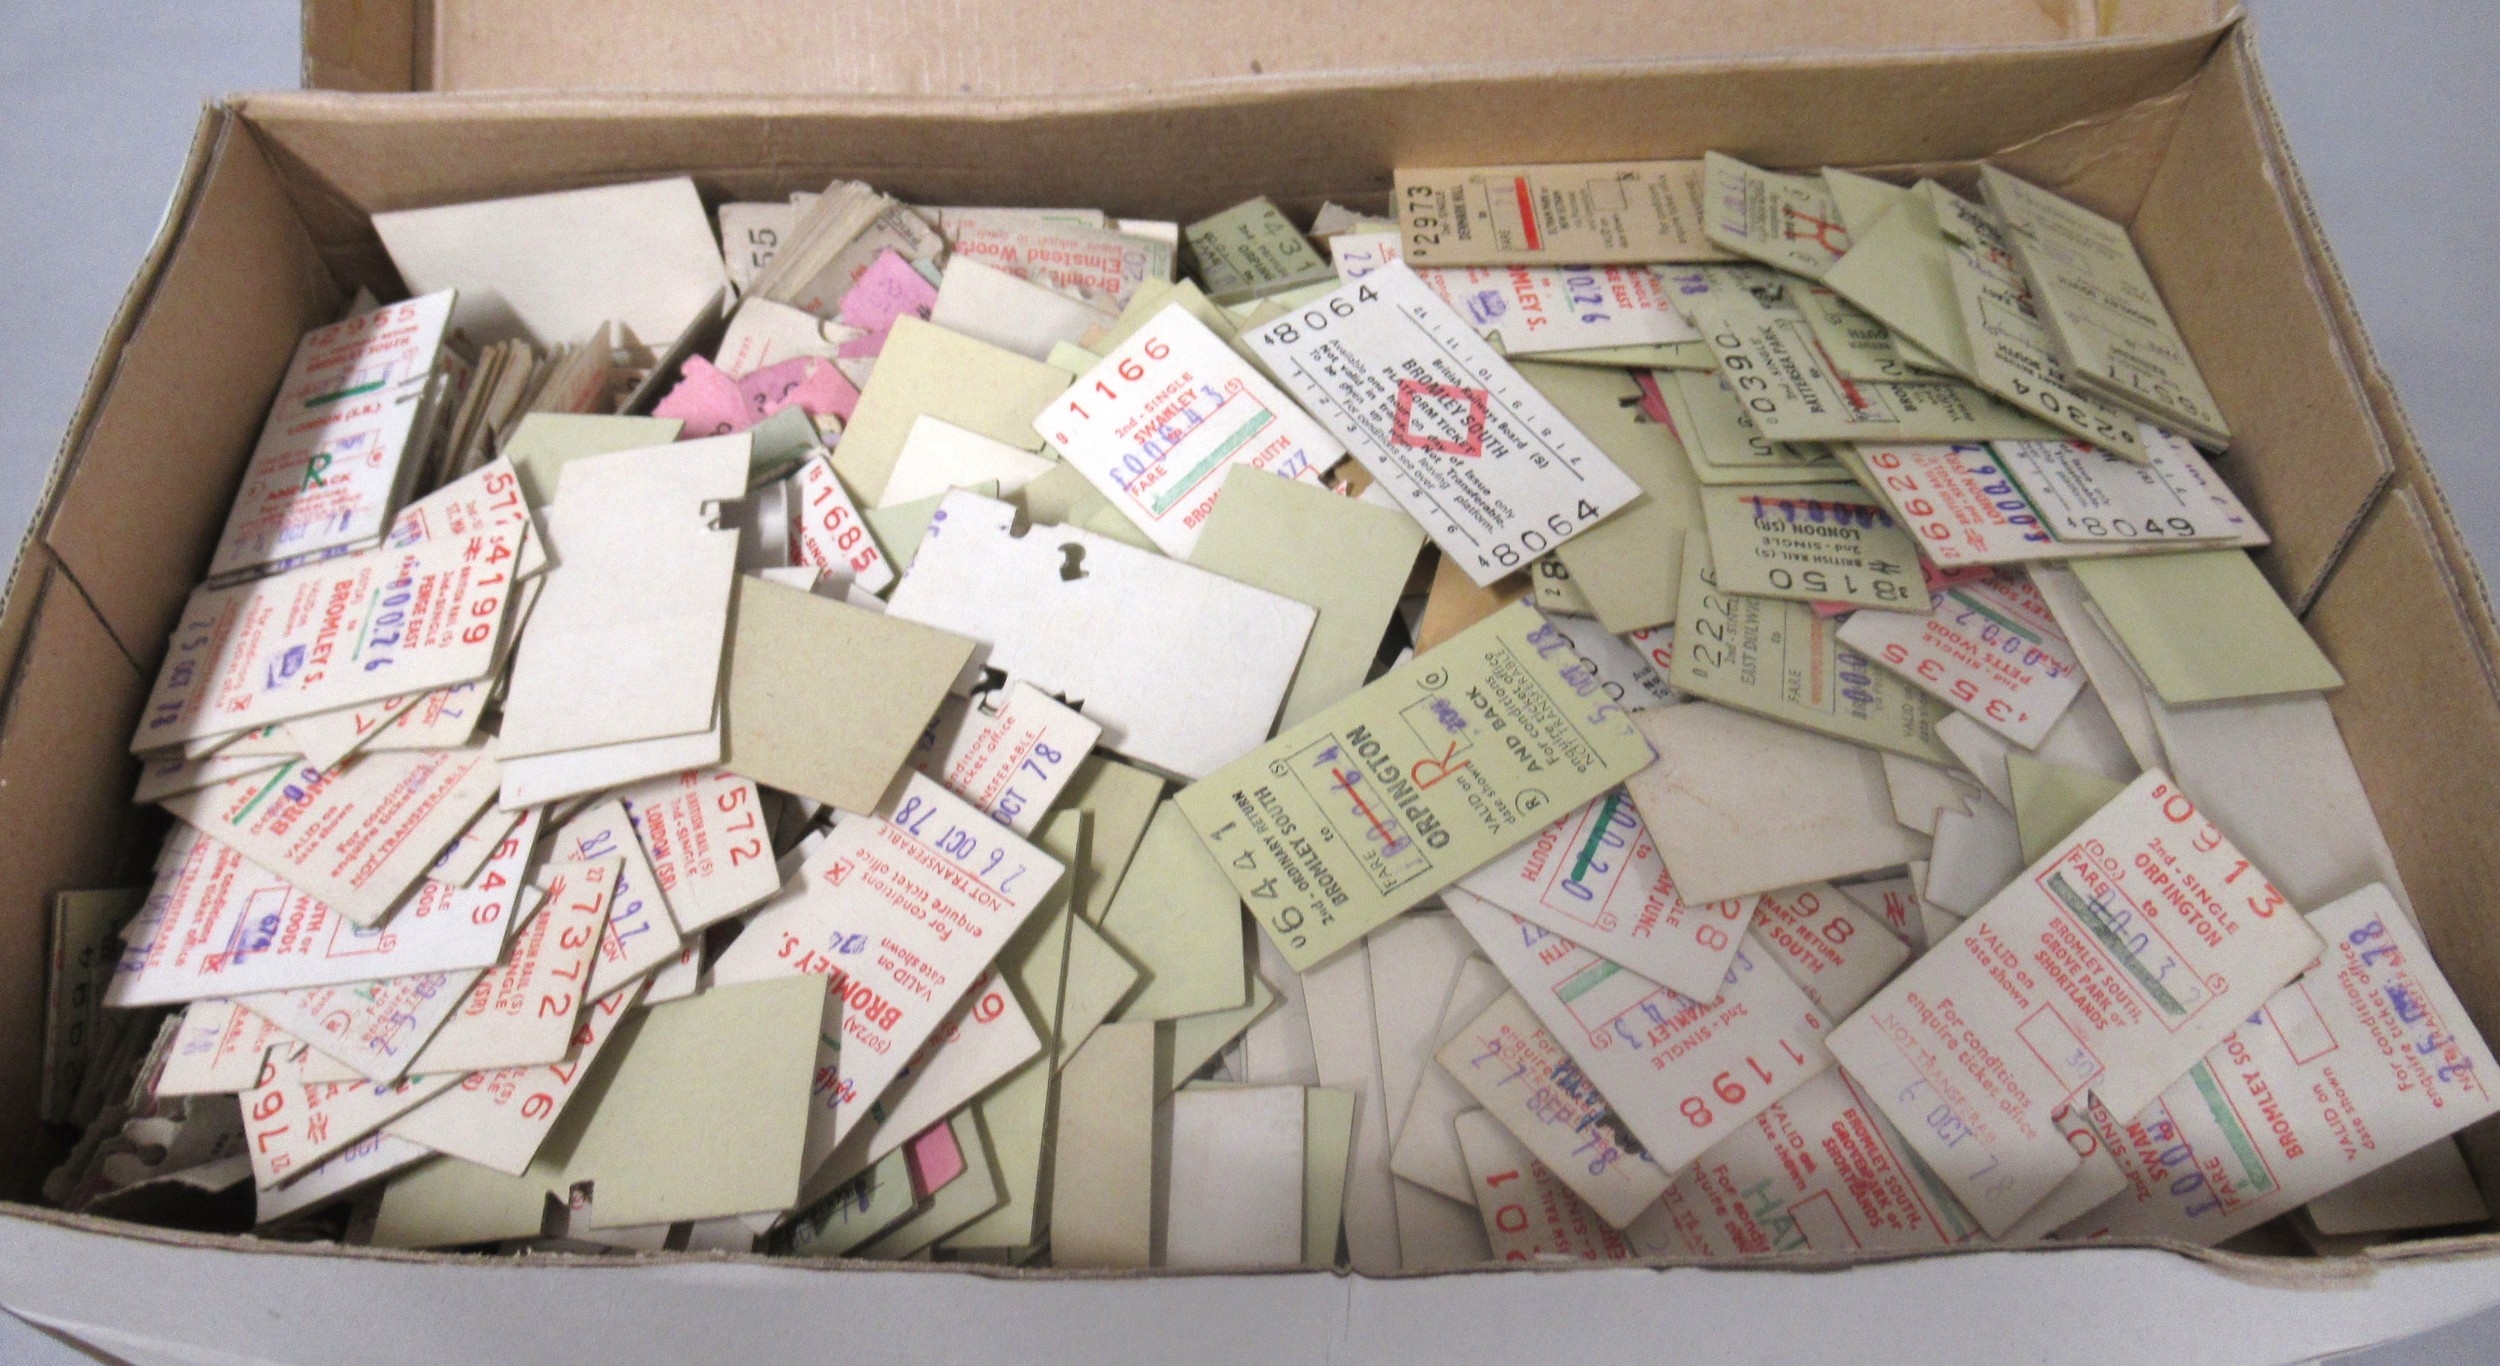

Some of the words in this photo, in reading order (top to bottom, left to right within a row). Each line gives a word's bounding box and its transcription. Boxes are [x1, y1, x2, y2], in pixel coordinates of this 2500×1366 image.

[1402, 358, 1468, 416] BROMLEY
[1460, 415, 1509, 459] SOUTH
[1437, 417, 1476, 454] TICKET
[1792, 523, 1861, 540] LONDON
[1465, 686, 1506, 731] BACK
[1346, 724, 1450, 849] ORPINGTON
[1506, 735, 1544, 773] AND
[1254, 785, 1296, 836] SOUTH
[1289, 837, 1350, 907] BROMLEY
[2133, 852, 2223, 949] ORPINGTON
[2182, 874, 2240, 937] SINGLE
[1977, 922, 2017, 970] VALID
[2039, 932, 2076, 974] GROVE
[2077, 975, 2110, 1015] PARK
[2048, 917, 2103, 976] BROMLEY
[2033, 951, 2110, 1032] SHORTLANDS
[1938, 998, 1964, 1026] For
[1963, 1031, 2031, 1108] conditions
[2242, 1068, 2305, 1161] BROMLEY
